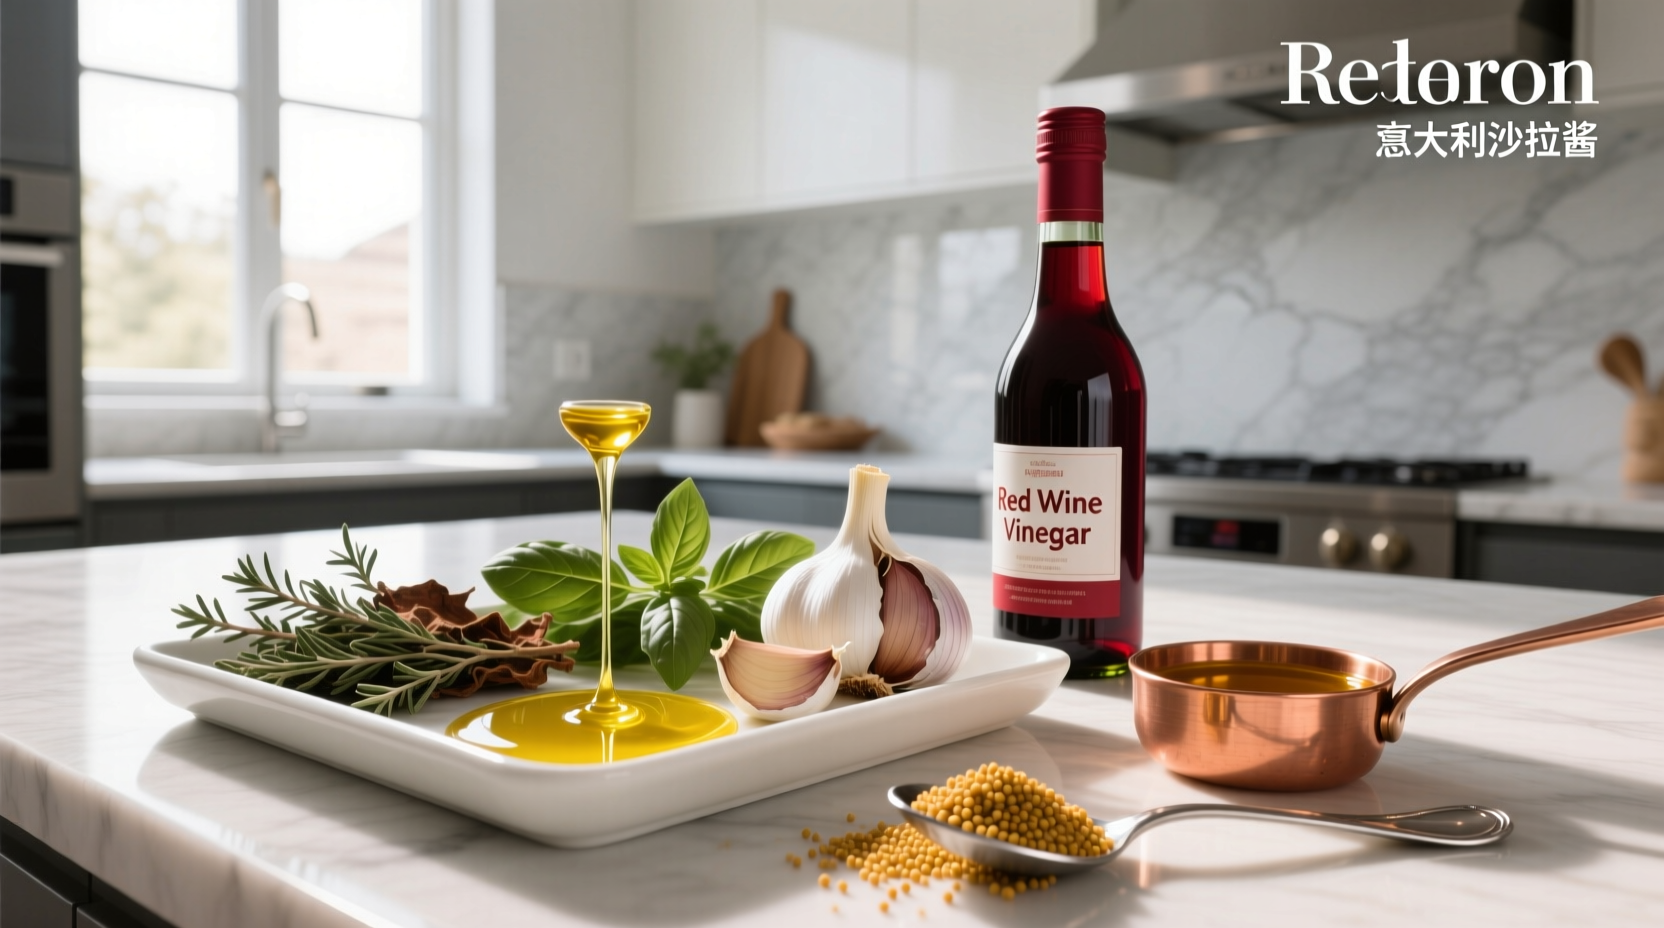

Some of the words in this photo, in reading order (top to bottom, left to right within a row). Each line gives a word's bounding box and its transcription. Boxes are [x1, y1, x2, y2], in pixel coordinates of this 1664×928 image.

[998, 487, 1031, 512] Red
[1037, 489, 1103, 514] Wine
[1003, 517, 1092, 551] Vinegar
